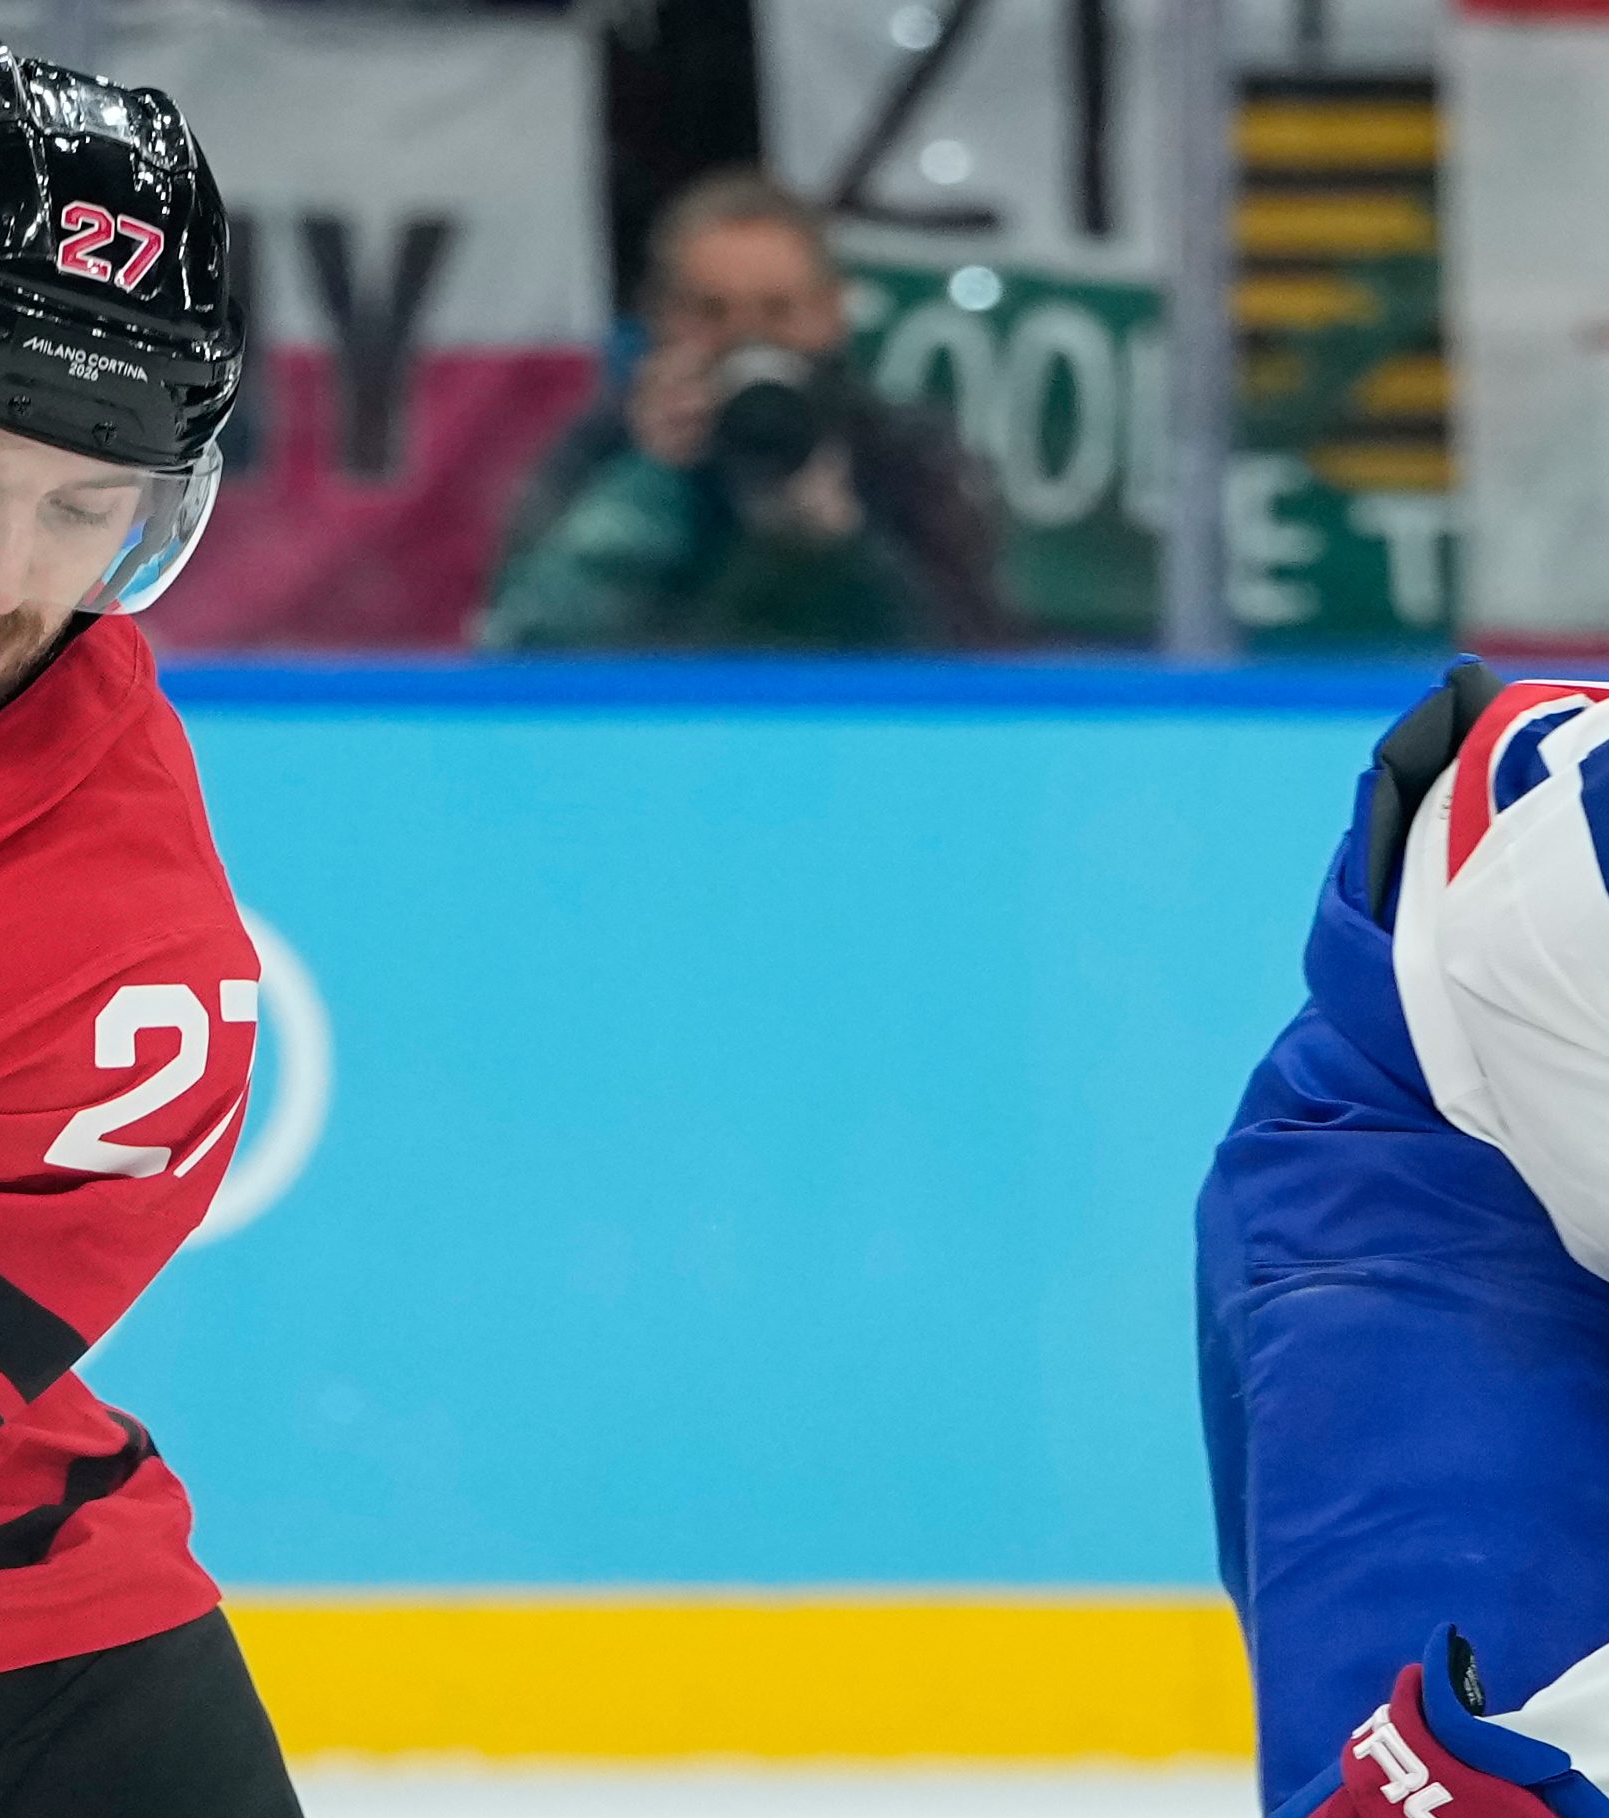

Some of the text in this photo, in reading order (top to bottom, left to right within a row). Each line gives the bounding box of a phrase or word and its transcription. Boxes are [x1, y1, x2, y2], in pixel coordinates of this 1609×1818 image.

[57, 200, 165, 294] 27
[22, 335, 149, 385] MILANO CORTINA
[68, 361, 100, 382] 2026
